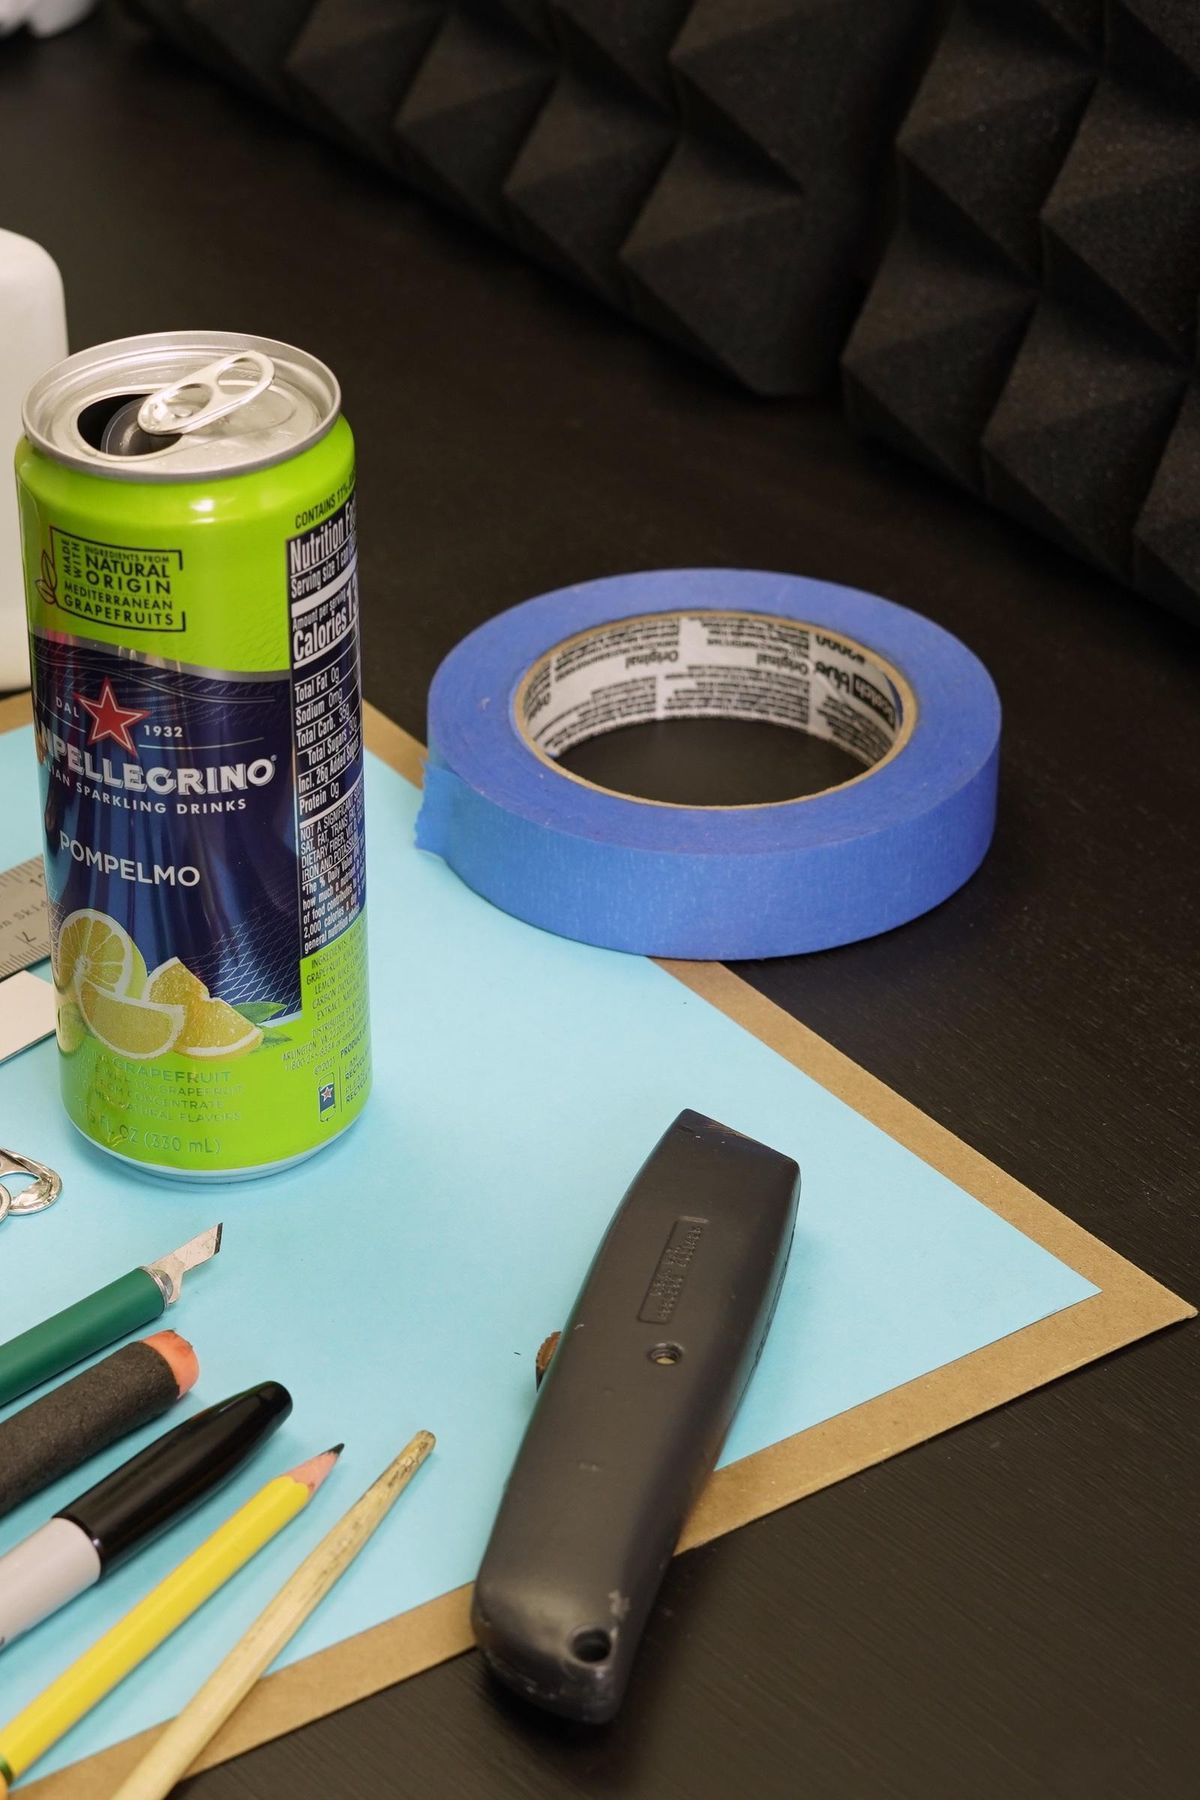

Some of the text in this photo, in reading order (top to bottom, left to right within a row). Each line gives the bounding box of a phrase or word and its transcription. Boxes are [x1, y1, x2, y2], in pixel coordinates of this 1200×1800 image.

[295, 494, 336, 529] CONTAINS
[62, 539, 71, 575] MADE
[71, 543, 82, 578] WITH
[85, 546, 169, 563] INGREDIENTS FROM
[290, 516, 344, 575] Nutrition
[85, 553, 171, 578] NATURAL
[291, 570, 321, 599] Serving
[322, 560, 335, 583] size
[64, 580, 173, 610] MEDITERRANEAN
[86, 570, 171, 595] ORIGIN
[64, 595, 174, 626] GRAPEFRUITS
[293, 607, 318, 632] Amount
[292, 605, 347, 661] Calories
[626, 651, 679, 669] Original
[756, 653, 808, 675] Original
[294, 667, 340, 703] Total Fat 0g
[816, 661, 850, 693] blue
[55, 697, 79, 718] DAL
[295, 687, 343, 726] Sodium 0mg
[144, 725, 183, 738] 1932
[296, 723, 316, 748] Total
[318, 716, 336, 738] Carb.
[307, 728, 347, 767] Total Sugars
[298, 770, 315, 794] Incl.
[316, 765, 329, 784] 26g
[329, 748, 346, 776] Added
[76, 782, 247, 815] SPARKLING DRINKS
[300, 790, 327, 815] Protein
[330, 782, 339, 799] 0g
[300, 823, 314, 841] NOT
[317, 821, 322, 833] A
[301, 838, 315, 855] SAT.
[331, 814, 348, 837] TRANS
[60, 830, 200, 887] POMPELMO
[301, 843, 329, 868] DIETARY
[301, 864, 319, 881] IRON
[320, 855, 333, 872] AND
[328, 866, 340, 883] Daily
[303, 896, 316, 911] how
[319, 884, 334, 903] much
[303, 911, 310, 924] of
[312, 902, 326, 920] food
[303, 906, 345, 939] 2,000 calories
[22, 931, 37, 943] 7
[304, 929, 327, 955] general
[112, 1057, 231, 1083] GRAPEFRUIT
